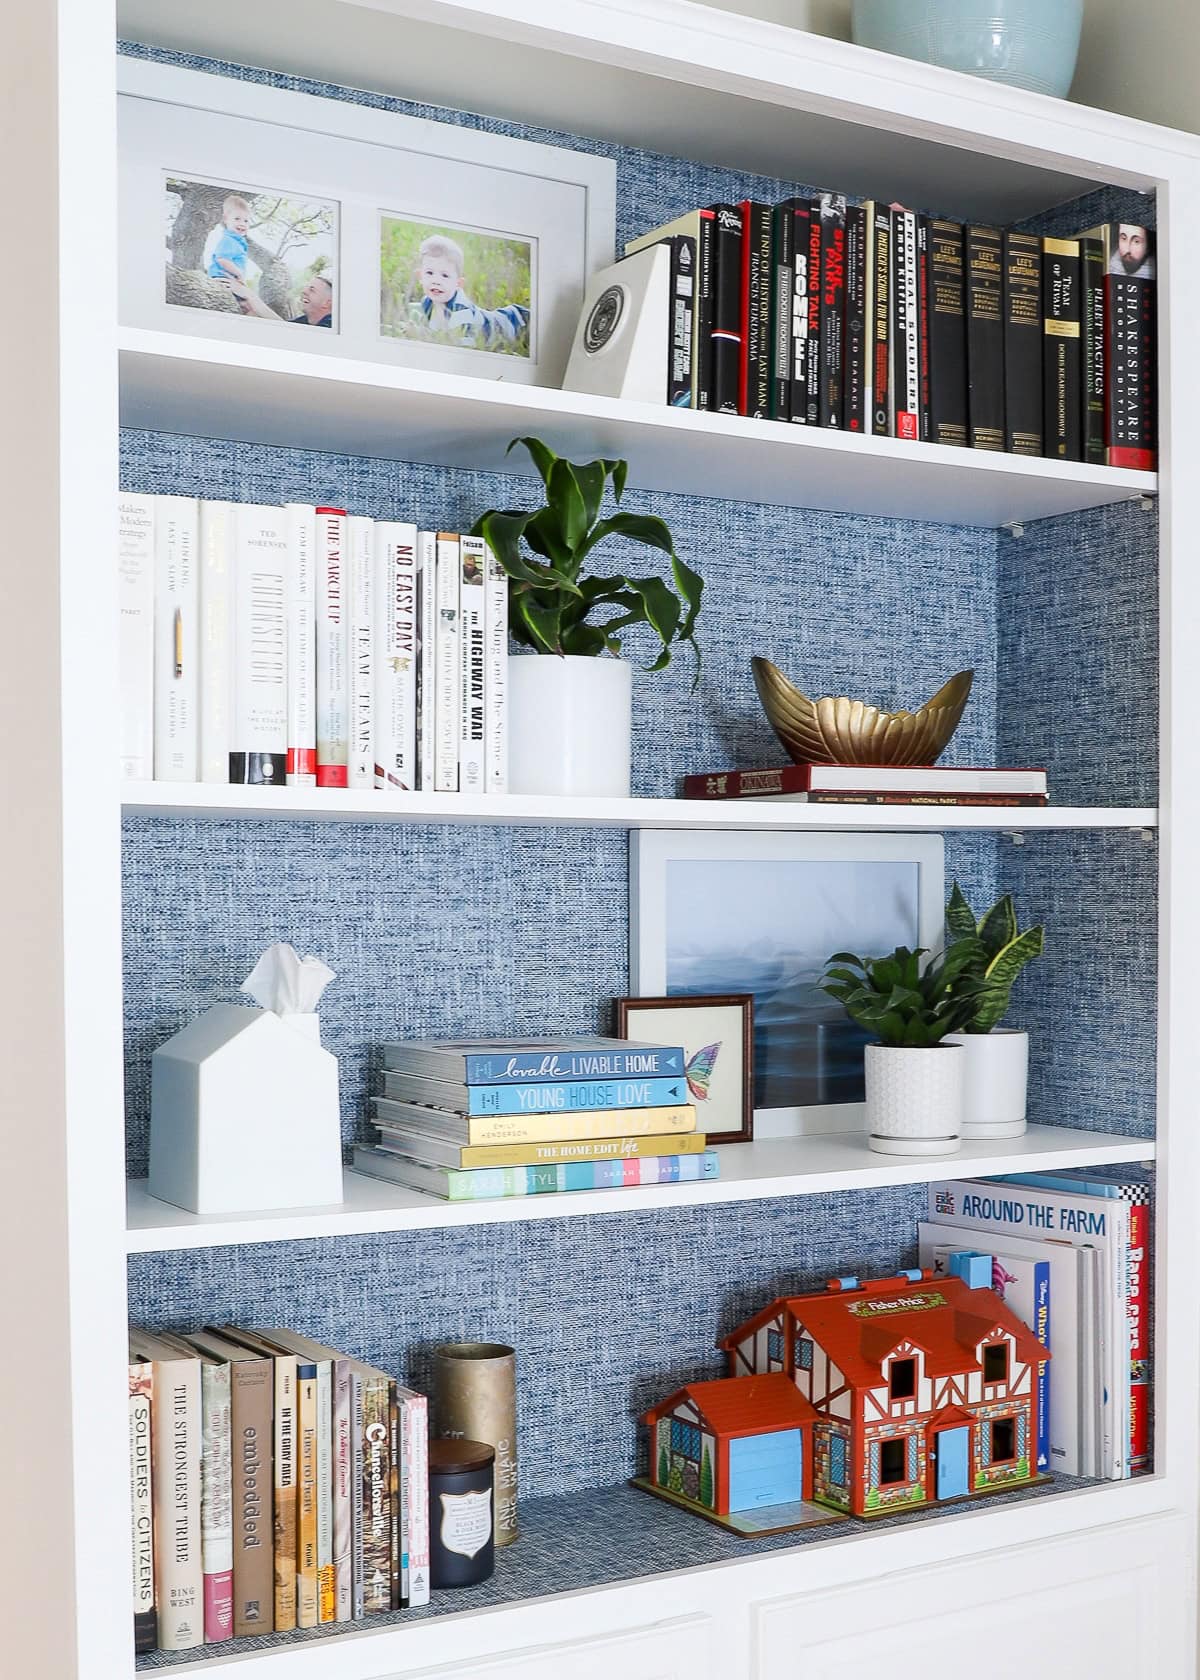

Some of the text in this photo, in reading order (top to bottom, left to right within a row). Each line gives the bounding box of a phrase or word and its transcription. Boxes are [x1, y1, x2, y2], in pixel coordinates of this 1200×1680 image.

[761, 210, 771, 230] THE
[760, 234, 770, 258] END
[760, 259, 770, 273] OF
[833, 228, 843, 288] SPARE
[877, 231, 888, 273] AMERICA'S
[779, 269, 789, 322] THEODORE
[808, 223, 820, 330] FIGHTING TALK
[824, 248, 835, 305] PARTS
[878, 273, 888, 303] SCHOOL
[897, 215, 906, 330] James Kitfield
[1052, 263, 1062, 317] OF RIVALS
[1061, 275, 1072, 306] TEAM
[749, 252, 760, 362] FRANCIS FUKUYAMA
[759, 278, 769, 324] HISTORY
[792, 253, 808, 382] ROMMEL
[878, 303, 888, 319] FOR
[906, 217, 916, 410] PRODIGAL SOLDIERS
[778, 322, 789, 377] ROOSEVELT
[852, 337, 859, 353] ED
[877, 319, 888, 341] WAR
[1094, 287, 1104, 395] FLEET TACTICS
[759, 354, 768, 378] LAST
[1126, 284, 1139, 440] SHAKESPEARE
[758, 381, 767, 408] MAN
[1117, 366, 1125, 439] EDITION
[168, 521, 177, 592] FAST SLOW
[327, 518, 341, 546] THE
[299, 525, 307, 593] TOM BROKAW
[327, 550, 341, 600] MARCH
[327, 604, 341, 625] UP
[395, 544, 414, 652] NO EASY DAY
[249, 572, 285, 686] COUNSELOR
[358, 624, 371, 753] TEAM TEAMS
[471, 629, 483, 700] HIGHWAY
[491, 590, 504, 761] The Sling and The Stone
[395, 714, 404, 749] OWEN
[471, 706, 483, 741] WAR
[494, 1056, 572, 1079] lovable
[571, 1056, 621, 1075] LIVABLE
[625, 1055, 659, 1072] HOME
[515, 1087, 565, 1109] YOUNG
[569, 1086, 613, 1107] HOUSE
[617, 1083, 653, 1104] LOVE
[481, 1130, 528, 1139] HENDERSON
[493, 1123, 516, 1131] EMILY
[536, 1137, 639, 1158] THE HOME EDIT life
[962, 1194, 1106, 1236] AROUND THE FARM
[1129, 1247, 1143, 1349] Race cars
[1038, 1305, 1047, 1344] Who's
[282, 1407, 292, 1487] IN THE GRAY AREA
[303, 1427, 315, 1514] FIRST TO FIGHT
[174, 1384, 189, 1563] THE STRONGEST TRIBE
[242, 1427, 262, 1550] embedded
[366, 1422, 387, 1537] Chancellorsville
[135, 1408, 152, 1600] SOLDIERS to CITIZENS
[212, 1480, 221, 1529] VICTORY
[305, 1543, 313, 1568] Krulak
[171, 1588, 195, 1597] BING
[171, 1597, 196, 1606] WEST
